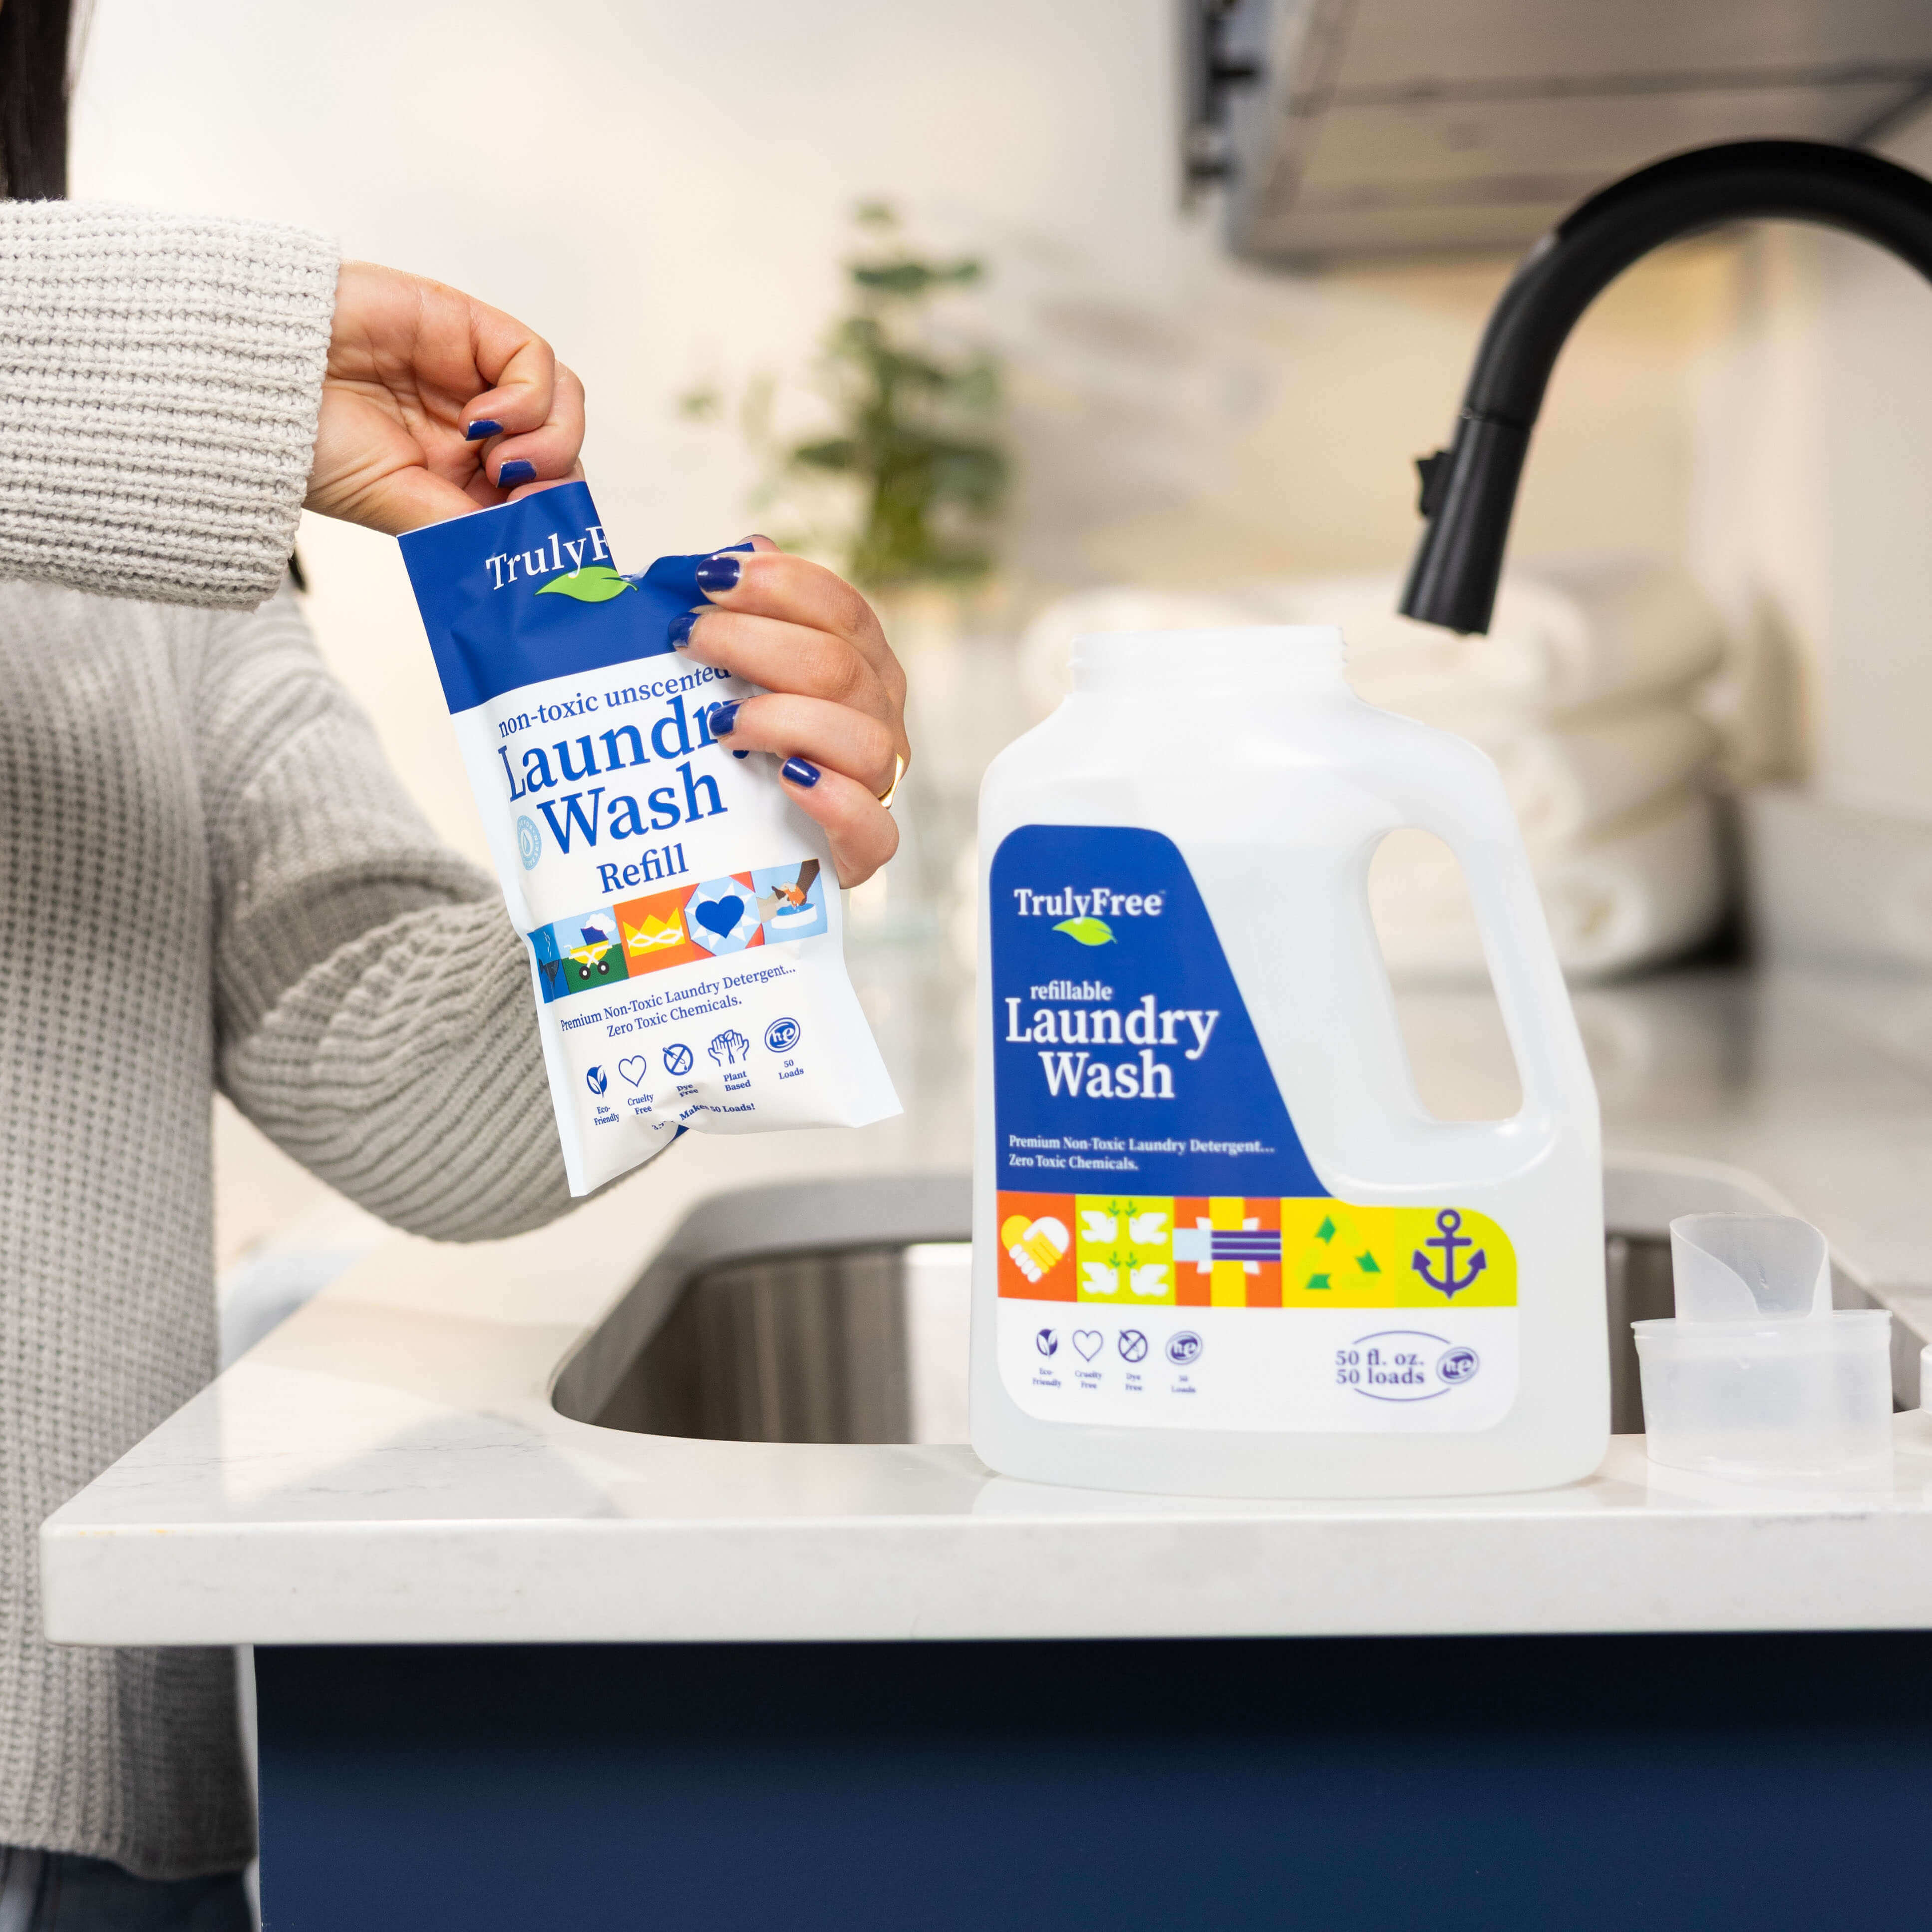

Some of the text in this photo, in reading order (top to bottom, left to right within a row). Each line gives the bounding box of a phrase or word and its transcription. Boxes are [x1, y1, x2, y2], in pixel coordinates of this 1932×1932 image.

[486, 526, 608, 590] TrulyF
[498, 692, 599, 738] non-toxic
[498, 694, 749, 802] Laundr
[536, 761, 728, 855] Wash
[596, 842, 689, 893] Refill
[1014, 887, 1162, 924] TrulyFree
[560, 965, 796, 1031] Premium Non-Toxic Laundry Detergent...
[1030, 980, 1113, 1000] refillable
[607, 995, 742, 1037] Zero Toxic Chemicals.
[1004, 995, 1220, 1060] Laundry
[783, 1059, 794, 1068] 50
[723, 1069, 747, 1082] Plant
[778, 1067, 804, 1080] Loads
[1038, 1049, 1175, 1098] Wash
[679, 1088, 699, 1097] Free
[725, 1080, 751, 1092] Based
[628, 1094, 653, 1106] Cruelty
[723, 1103, 756, 1113] Loads!
[594, 1113, 619, 1126] Friendly
[635, 1105, 652, 1115] Free
[1008, 1134, 1275, 1156] Premium Non-Toxic Laundry Detergent...
[1008, 1154, 1139, 1171] Zero Toxic Chemicals.
[1335, 1347, 1424, 1366] 50 fl. oz.
[1335, 1366, 1425, 1384] 50 loads
